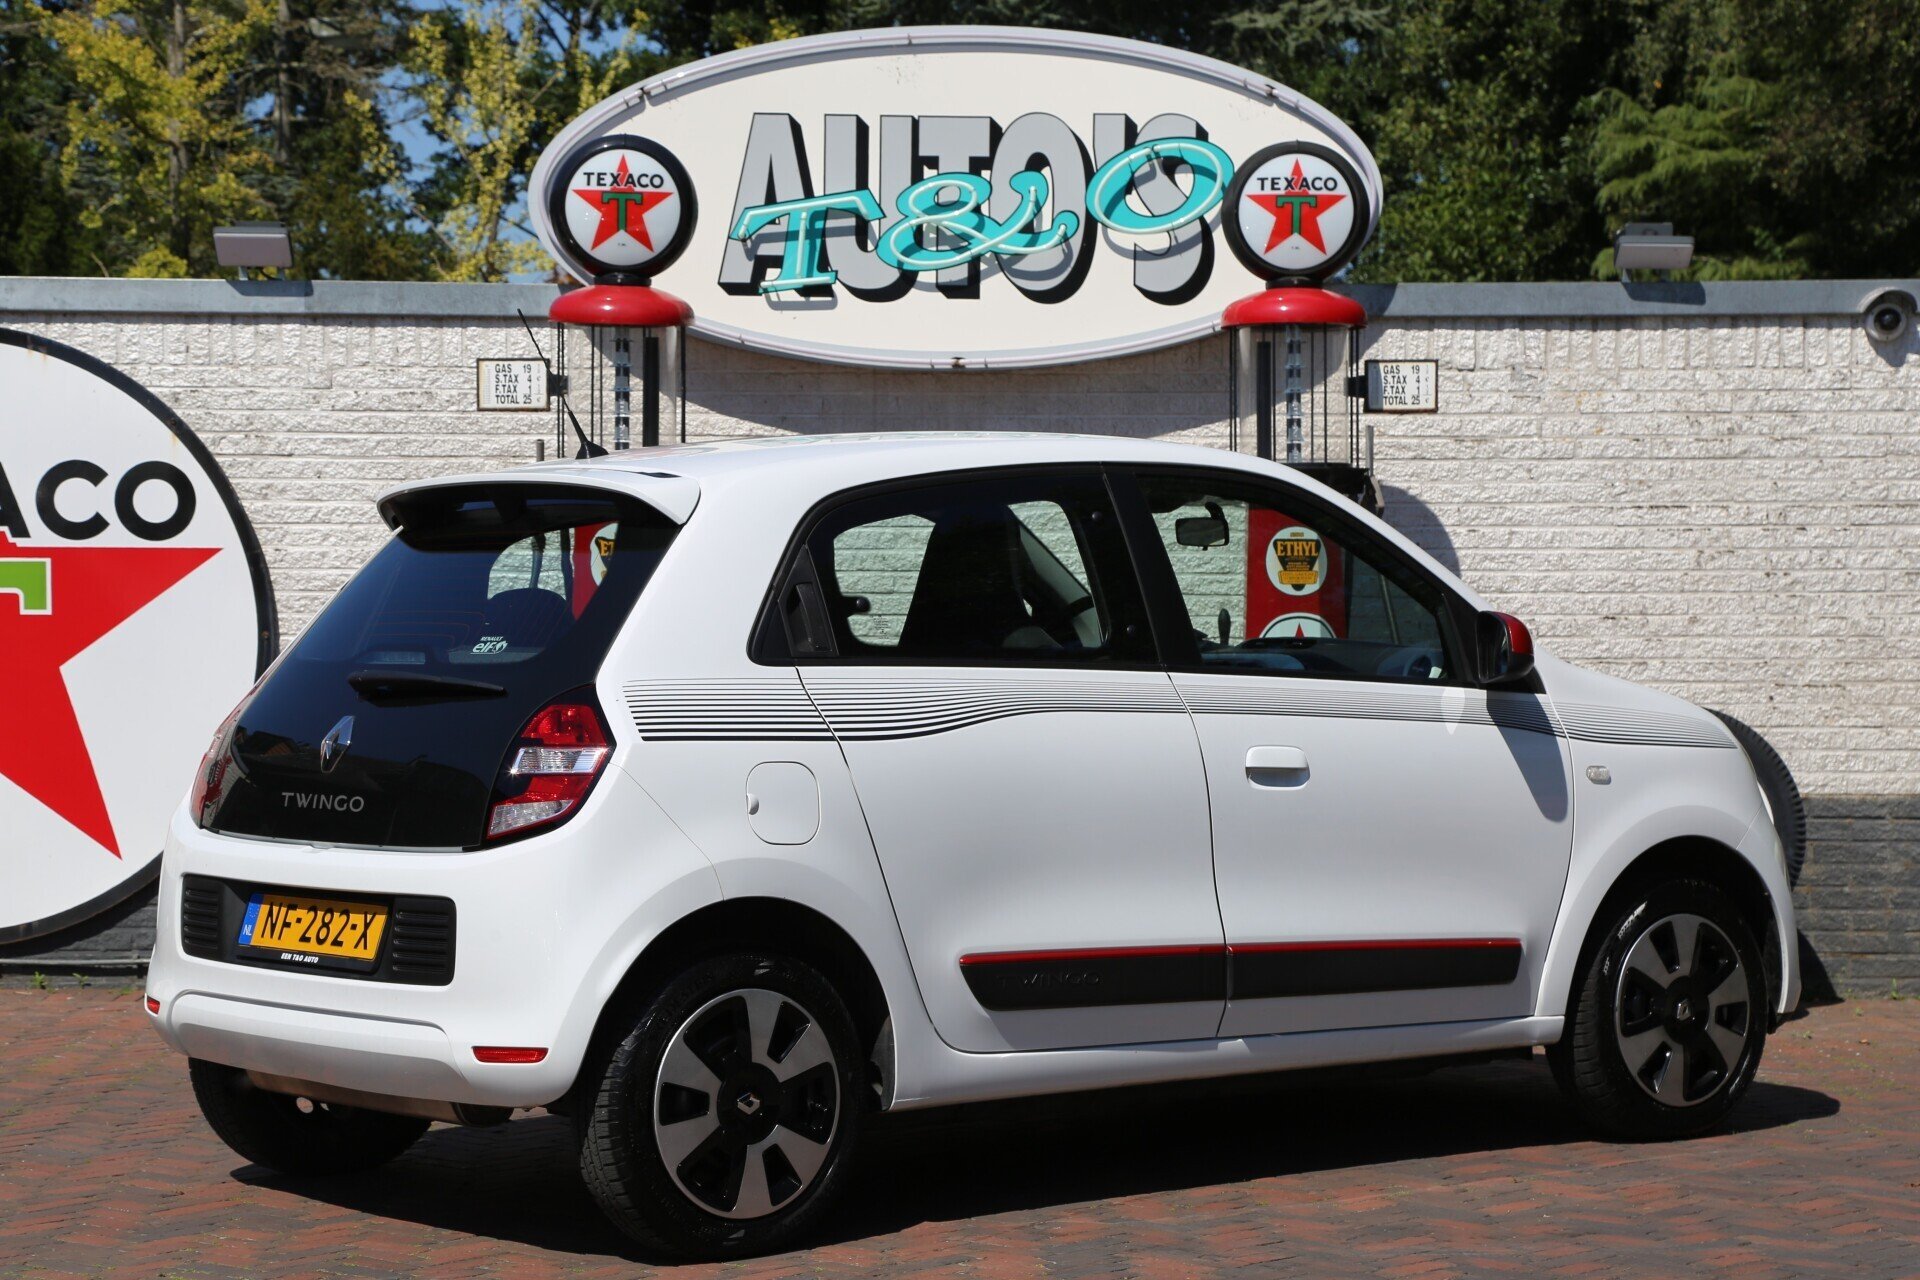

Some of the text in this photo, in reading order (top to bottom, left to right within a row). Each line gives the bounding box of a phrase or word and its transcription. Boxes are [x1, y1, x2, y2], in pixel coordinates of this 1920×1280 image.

[583, 172, 664, 189] TEXACO
[1257, 177, 1338, 191] TEXACO
[602, 191, 644, 232] T
[1276, 195, 1318, 235] T
[495, 364, 532, 373] GAS 19
[1383, 365, 1420, 374] GAS 19
[495, 374, 532, 384] S.TAX 4
[1383, 375, 1420, 385] S.TAX 4
[495, 385, 517, 394] F.TAX
[1383, 386, 1406, 395] F.TAX
[495, 395, 532, 404] TOTAL 25
[1383, 396, 1420, 405] TOTAL 25
[1277, 541, 1318, 556] ETHYL
[281, 792, 365, 812] TWINGO
[243, 924, 252, 936] NL
[261, 902, 377, 950] NF-282-X
[304, 955, 319, 963] AUTO
